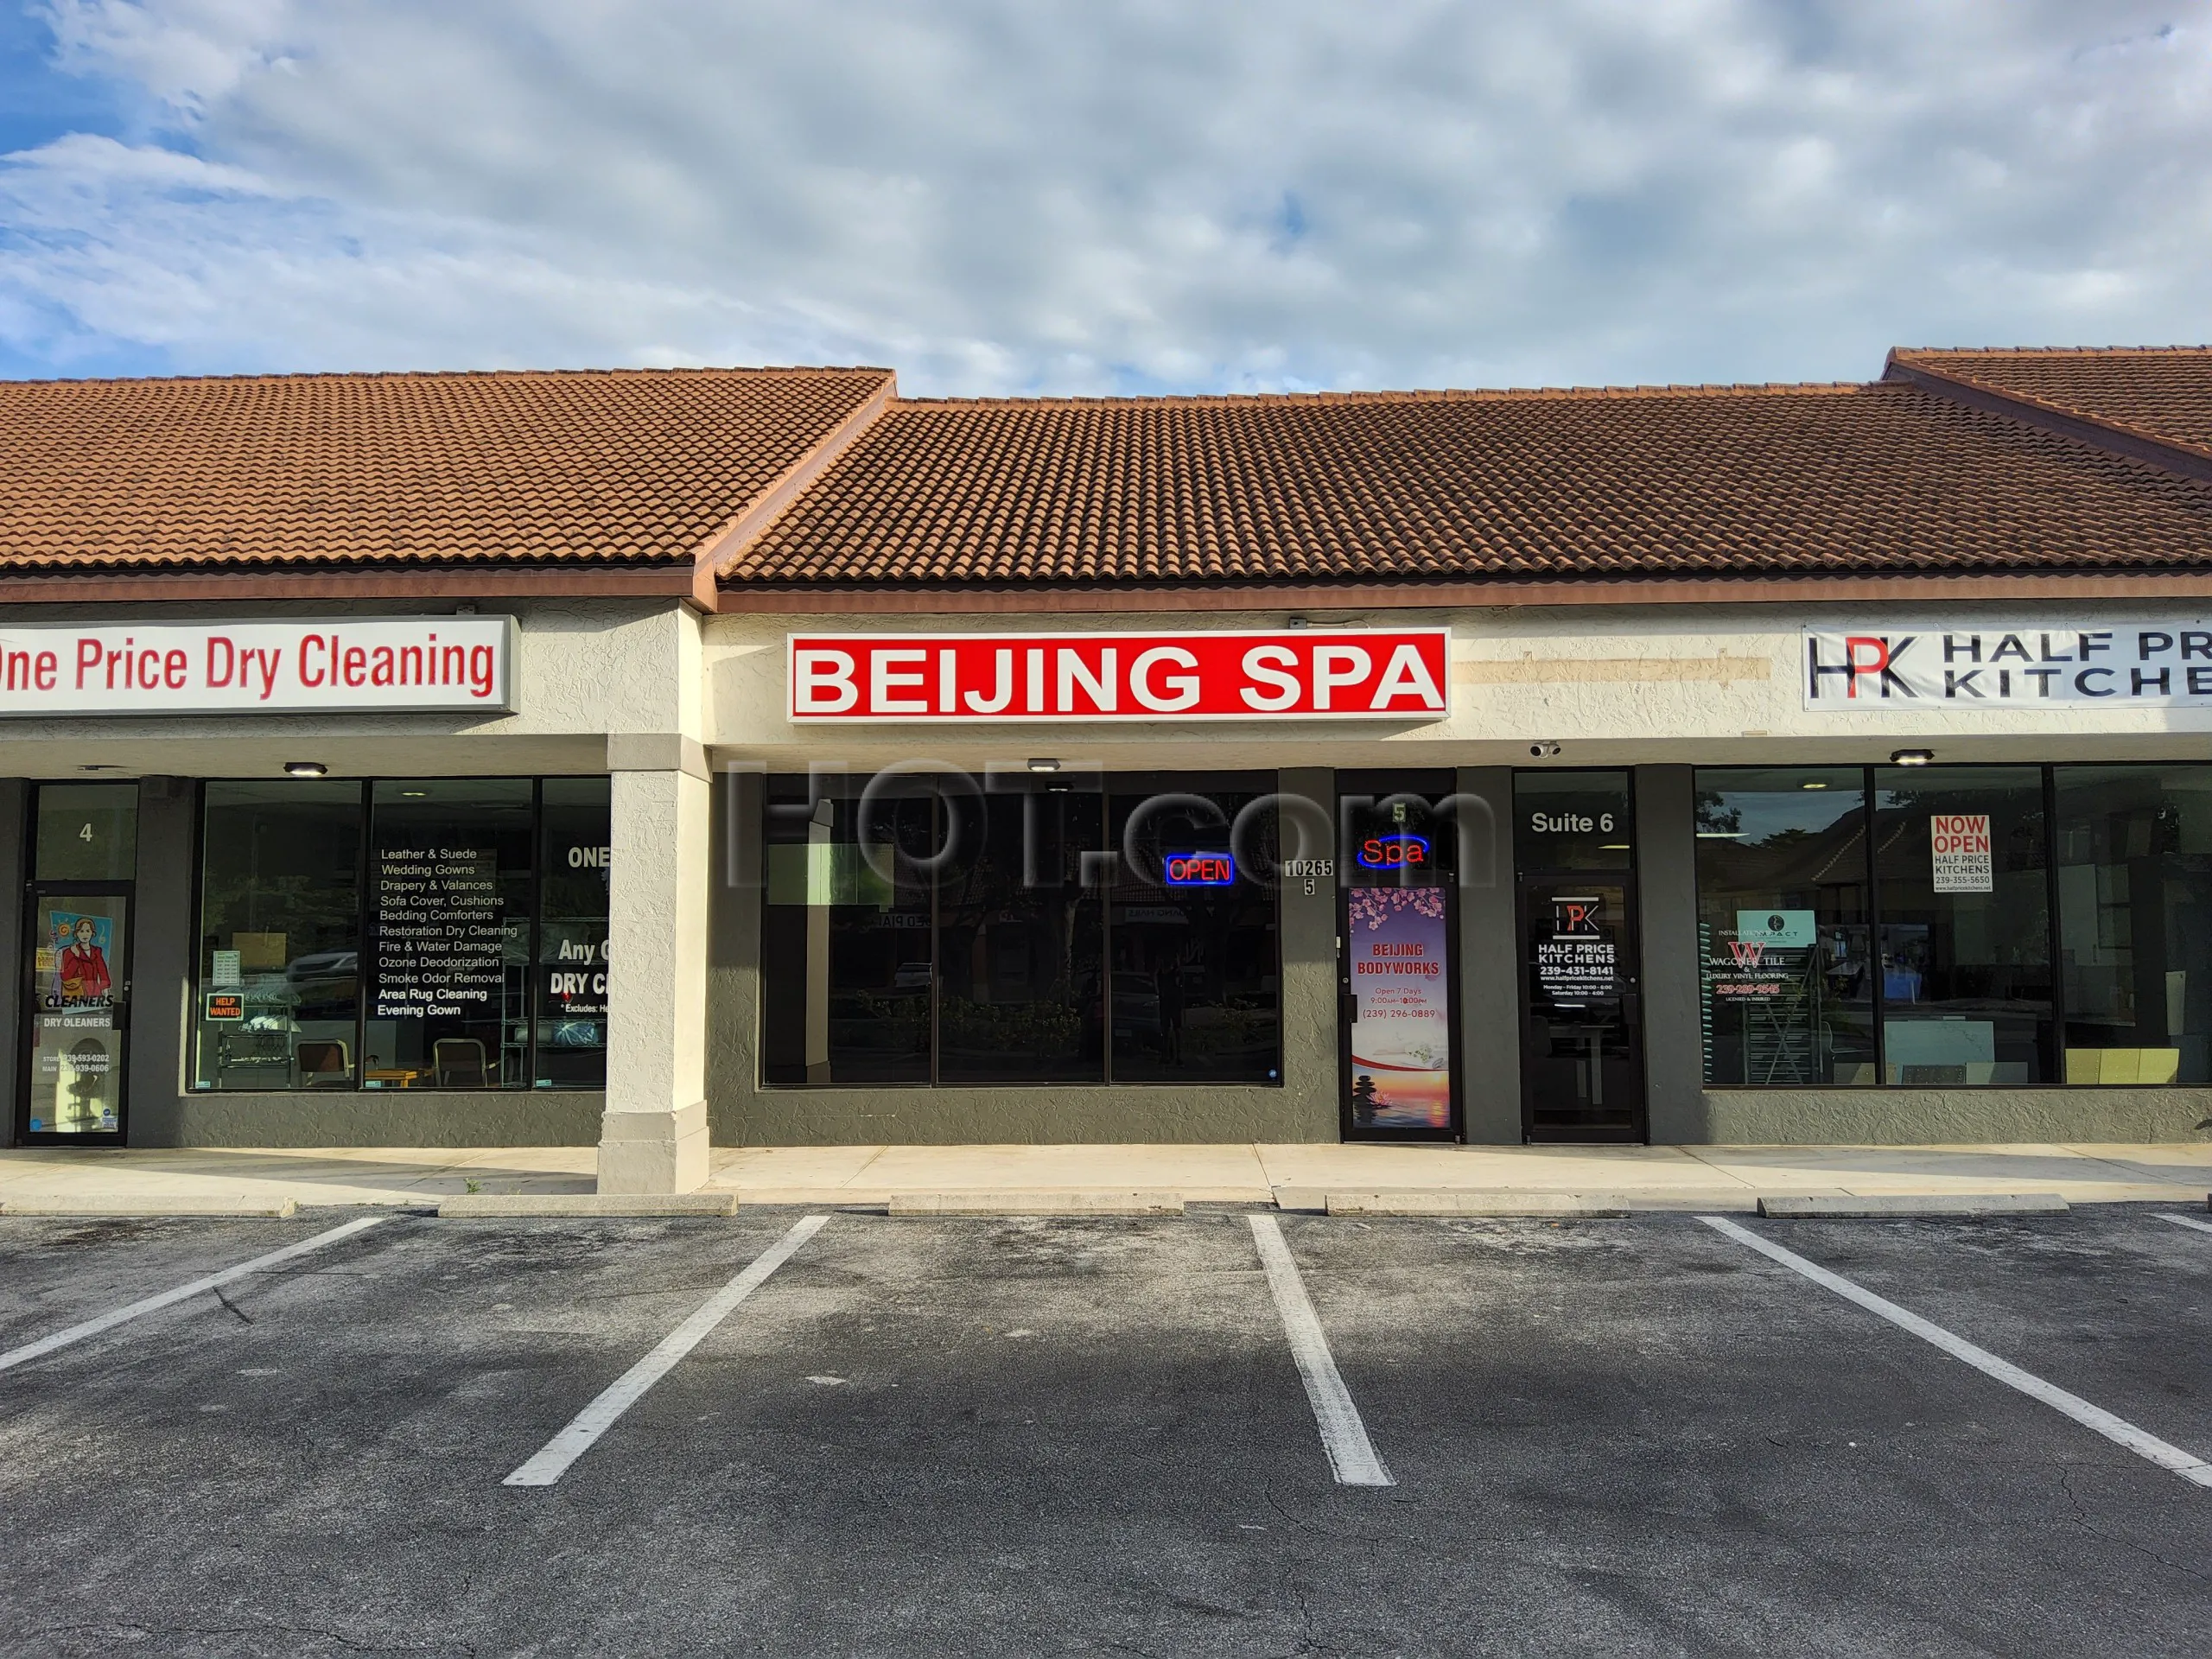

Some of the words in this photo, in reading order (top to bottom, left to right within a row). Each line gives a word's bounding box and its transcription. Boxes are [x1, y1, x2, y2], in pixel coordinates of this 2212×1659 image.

[1943, 632, 2113, 664] HALF
[2139, 631, 2212, 661] PR
[0, 643, 57, 691] ne
[76, 638, 187, 690] Price
[207, 636, 281, 700] Dry
[300, 633, 493, 697] Cleaning
[795, 646, 1201, 714] BEIJING
[1239, 645, 1445, 711] SPA
[1944, 666, 2212, 699] KITCHE
[1394, 804, 1405, 822] 5
[1531, 812, 1593, 832] Suite
[1599, 813, 1613, 832] 6
[1936, 817, 1985, 834] NOW
[79, 823, 92, 842] 4
[1934, 836, 1989, 853] OPEN
[381, 849, 425, 860] Leather
[428, 849, 436, 859] &
[440, 849, 477, 859] Suede
[568, 847, 610, 868] ONE
[1363, 839, 1424, 864] Spa
[1935, 855, 1959, 864] HALF
[1961, 855, 1989, 864] PRICE
[381, 864, 432, 877] Wedding
[435, 864, 475, 874] Gowns
[1168, 859, 1230, 880] OPEN
[1287, 861, 1332, 876] 10265
[1936, 865, 1990, 874] KITCHENS
[380, 880, 426, 893] Drapery
[429, 880, 438, 890] &
[442, 880, 493, 890] Valances
[1305, 880, 1314, 894] 5
[380, 895, 406, 906] Sofa
[410, 895, 447, 906] Cover,
[450, 895, 504, 906] Cushions
[380, 910, 427, 922] Bedding
[430, 910, 493, 920] Comforters
[379, 925, 442, 936] Restoration
[446, 925, 465, 938] Dry
[468, 925, 518, 938] Cleaning
[378, 941, 401, 951] Fire
[404, 941, 413, 951] &
[416, 941, 450, 951] Water
[454, 941, 502, 953] Damage
[558, 939, 595, 965] Any
[1372, 944, 1424, 957] BEIJING
[1538, 944, 1573, 953] HALF
[1576, 944, 1615, 953] PRICE
[1538, 954, 1615, 963] KITCHENS
[1728, 942, 1765, 968] W
[378, 957, 416, 967] Ozone
[420, 957, 499, 967] Deodorization
[1357, 962, 1440, 976] BODYWORKS
[1540, 967, 1613, 976] 239-431-8141
[378, 973, 418, 983] Smoke
[422, 973, 450, 983] Odor
[454, 973, 505, 983] Removal
[550, 973, 588, 994] DRY
[45, 995, 114, 1007] CLEANERS
[378, 989, 406, 1000] Area
[410, 988, 433, 1001] Rug
[436, 988, 487, 1001] Cleaning
[215, 997, 235, 1006] HELP
[210, 1007, 240, 1016] WANTED
[378, 1005, 424, 1017] Evening
[427, 1005, 461, 1015] Gown
[1363, 1009, 1387, 1019] (239)
[1390, 1009, 1435, 1018] 296-0889
[44, 1018, 61, 1027] DRY
[64, 1018, 111, 1027] CLEANERS
